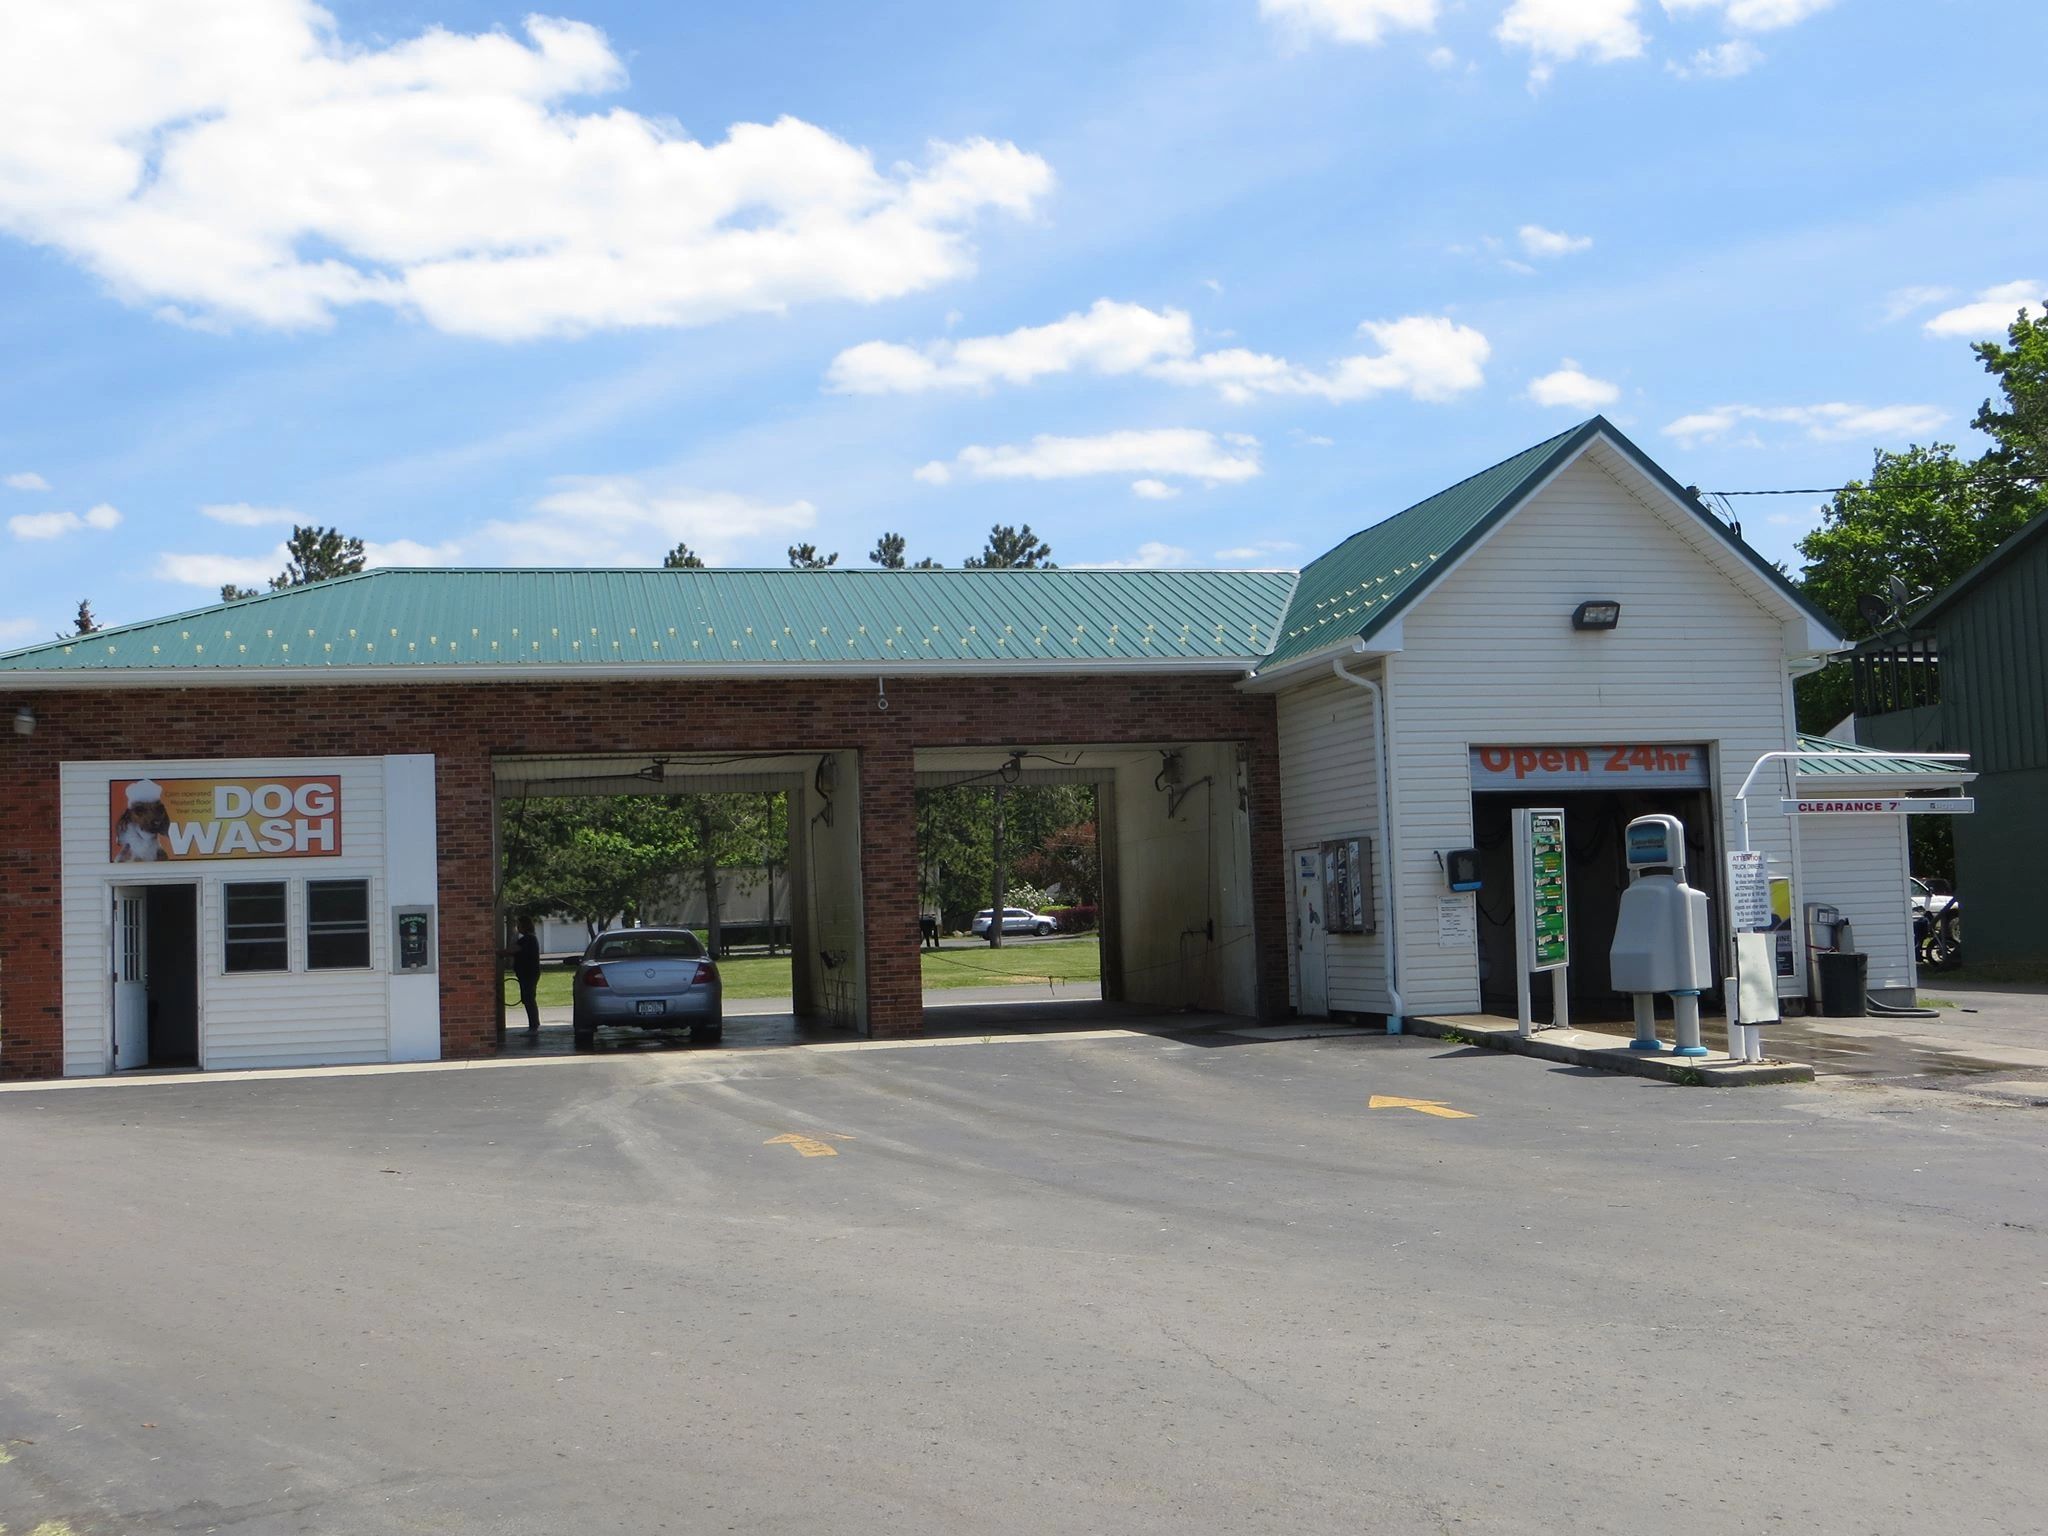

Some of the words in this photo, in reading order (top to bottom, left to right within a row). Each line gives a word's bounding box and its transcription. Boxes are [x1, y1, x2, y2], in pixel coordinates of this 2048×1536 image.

[1480, 746, 1589, 779] Open
[1604, 745, 1690, 771] 24hr
[215, 783, 335, 819] DOG
[1798, 802, 1882, 812] CLEARANCE
[168, 819, 335, 855] WASH
